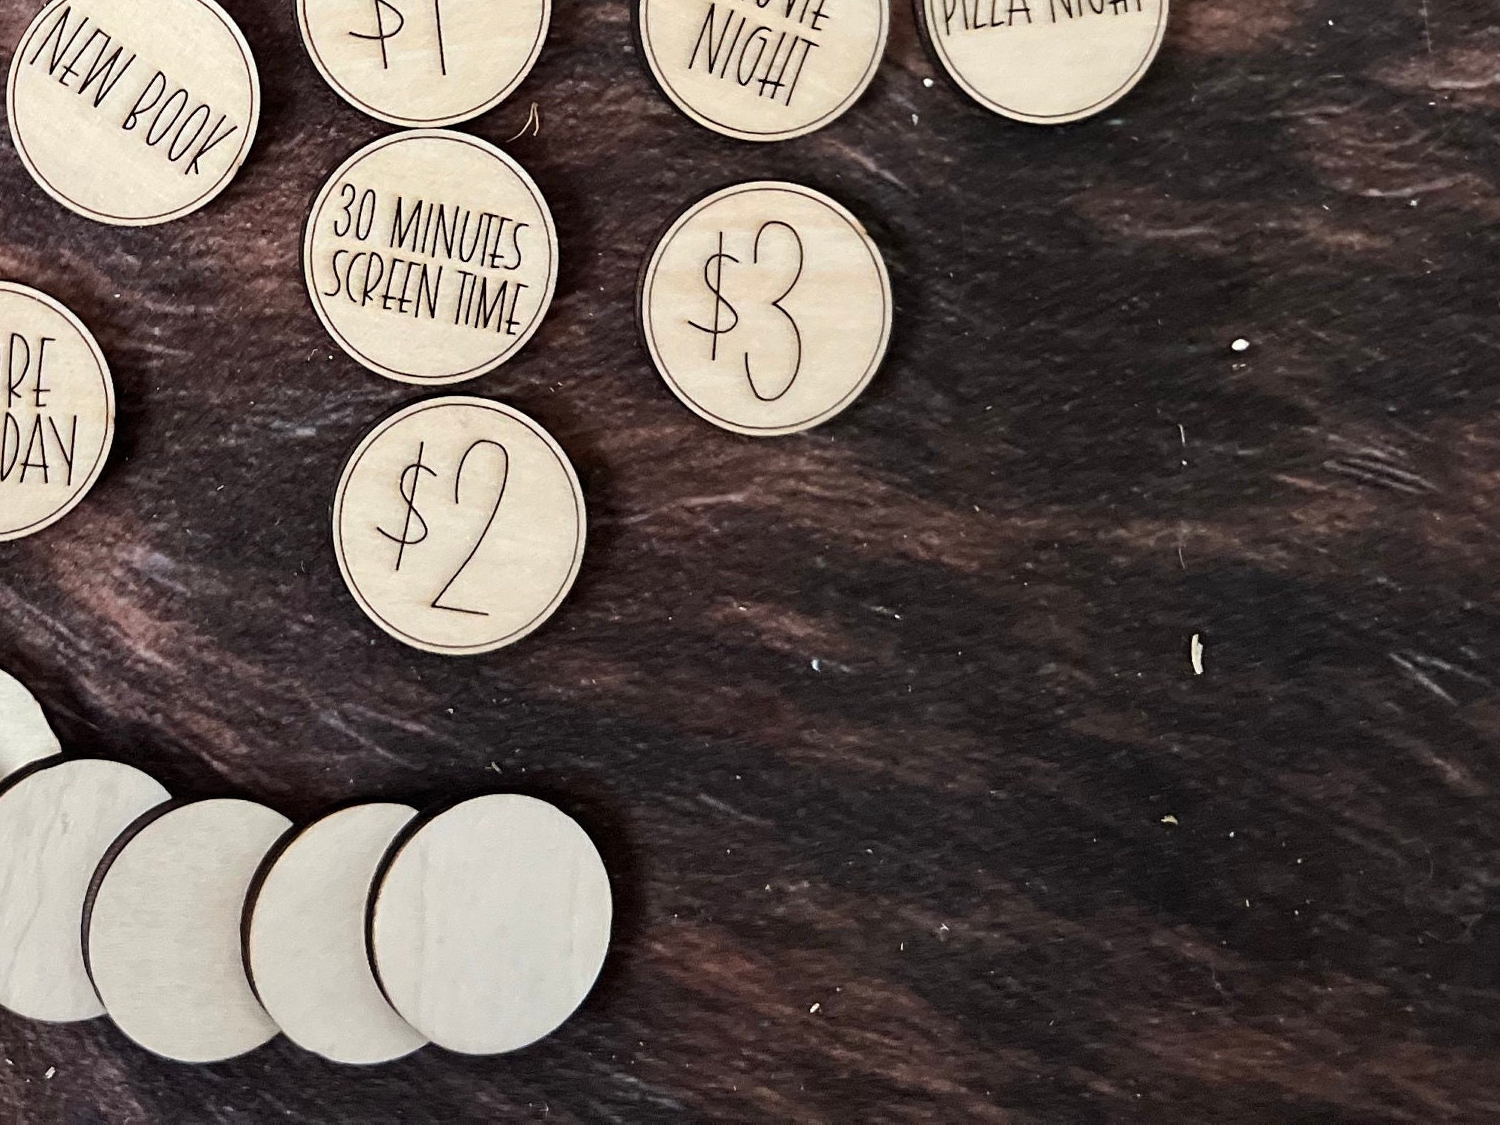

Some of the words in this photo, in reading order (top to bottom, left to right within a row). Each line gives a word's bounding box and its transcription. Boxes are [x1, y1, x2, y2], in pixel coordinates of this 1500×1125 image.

[29, 5, 126, 97] NEW
[121, 70, 239, 176] BOOK
[687, 2, 820, 107] NIGHT
[333, 182, 377, 242] 30
[389, 196, 530, 271] MINUTES
[323, 249, 444, 319] SCREEN
[454, 269, 530, 336] TIME
[686, 220, 804, 402] $3
[0, 411, 78, 487] DAY
[375, 438, 509, 617] $2
